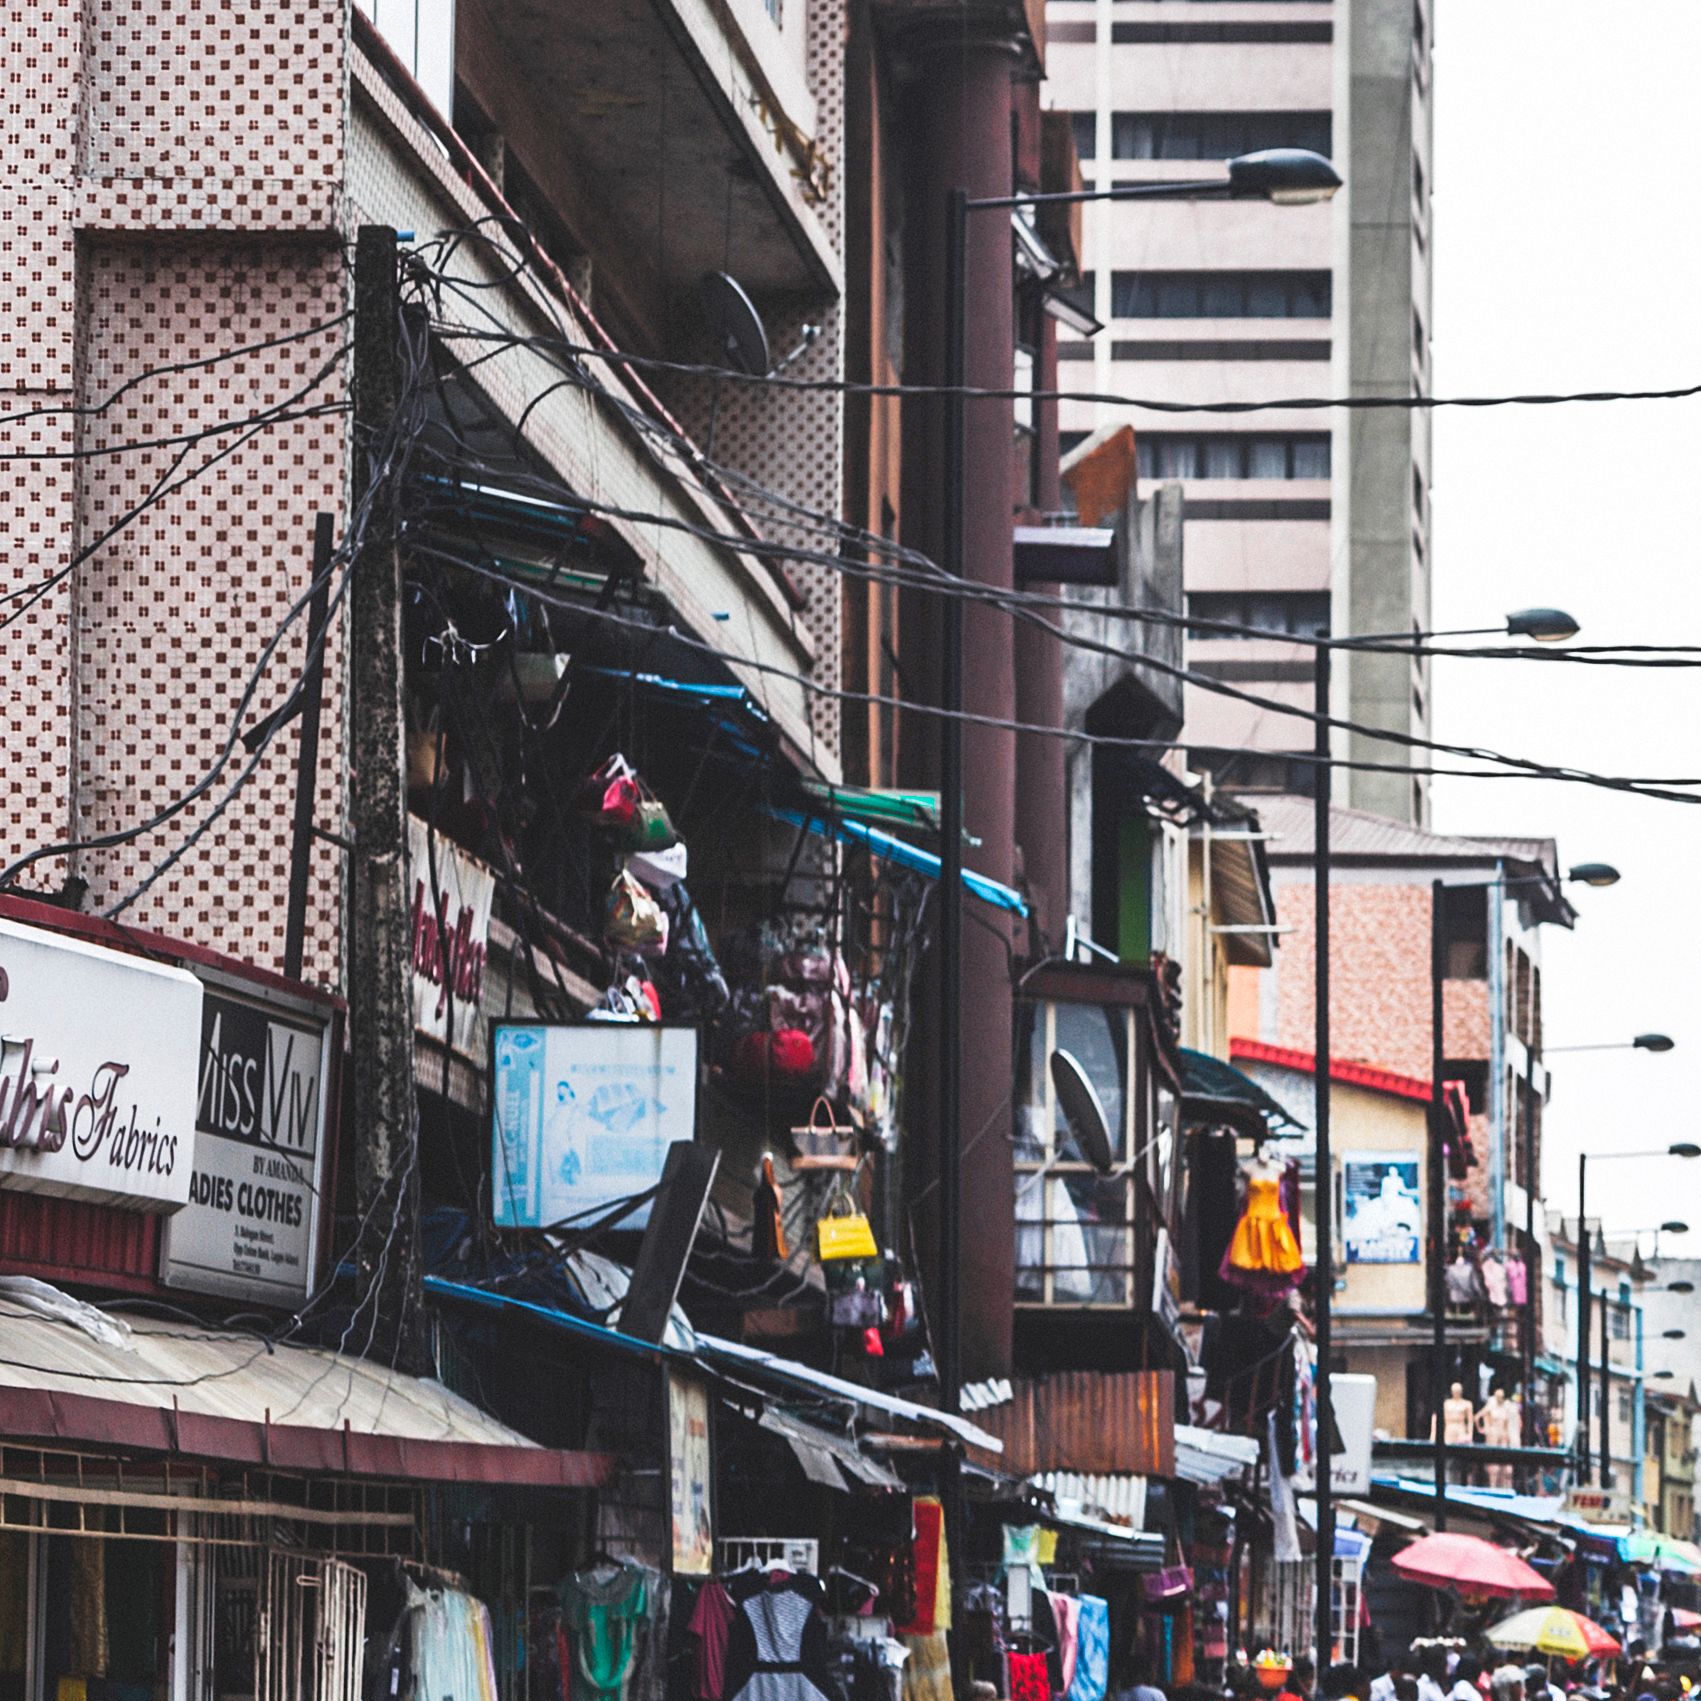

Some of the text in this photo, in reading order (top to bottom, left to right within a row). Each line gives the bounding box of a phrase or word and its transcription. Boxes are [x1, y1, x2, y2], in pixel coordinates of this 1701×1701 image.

[72, 1061, 178, 1176] Fabrics
[189, 1170, 303, 1229] ADIES CLOTHES
